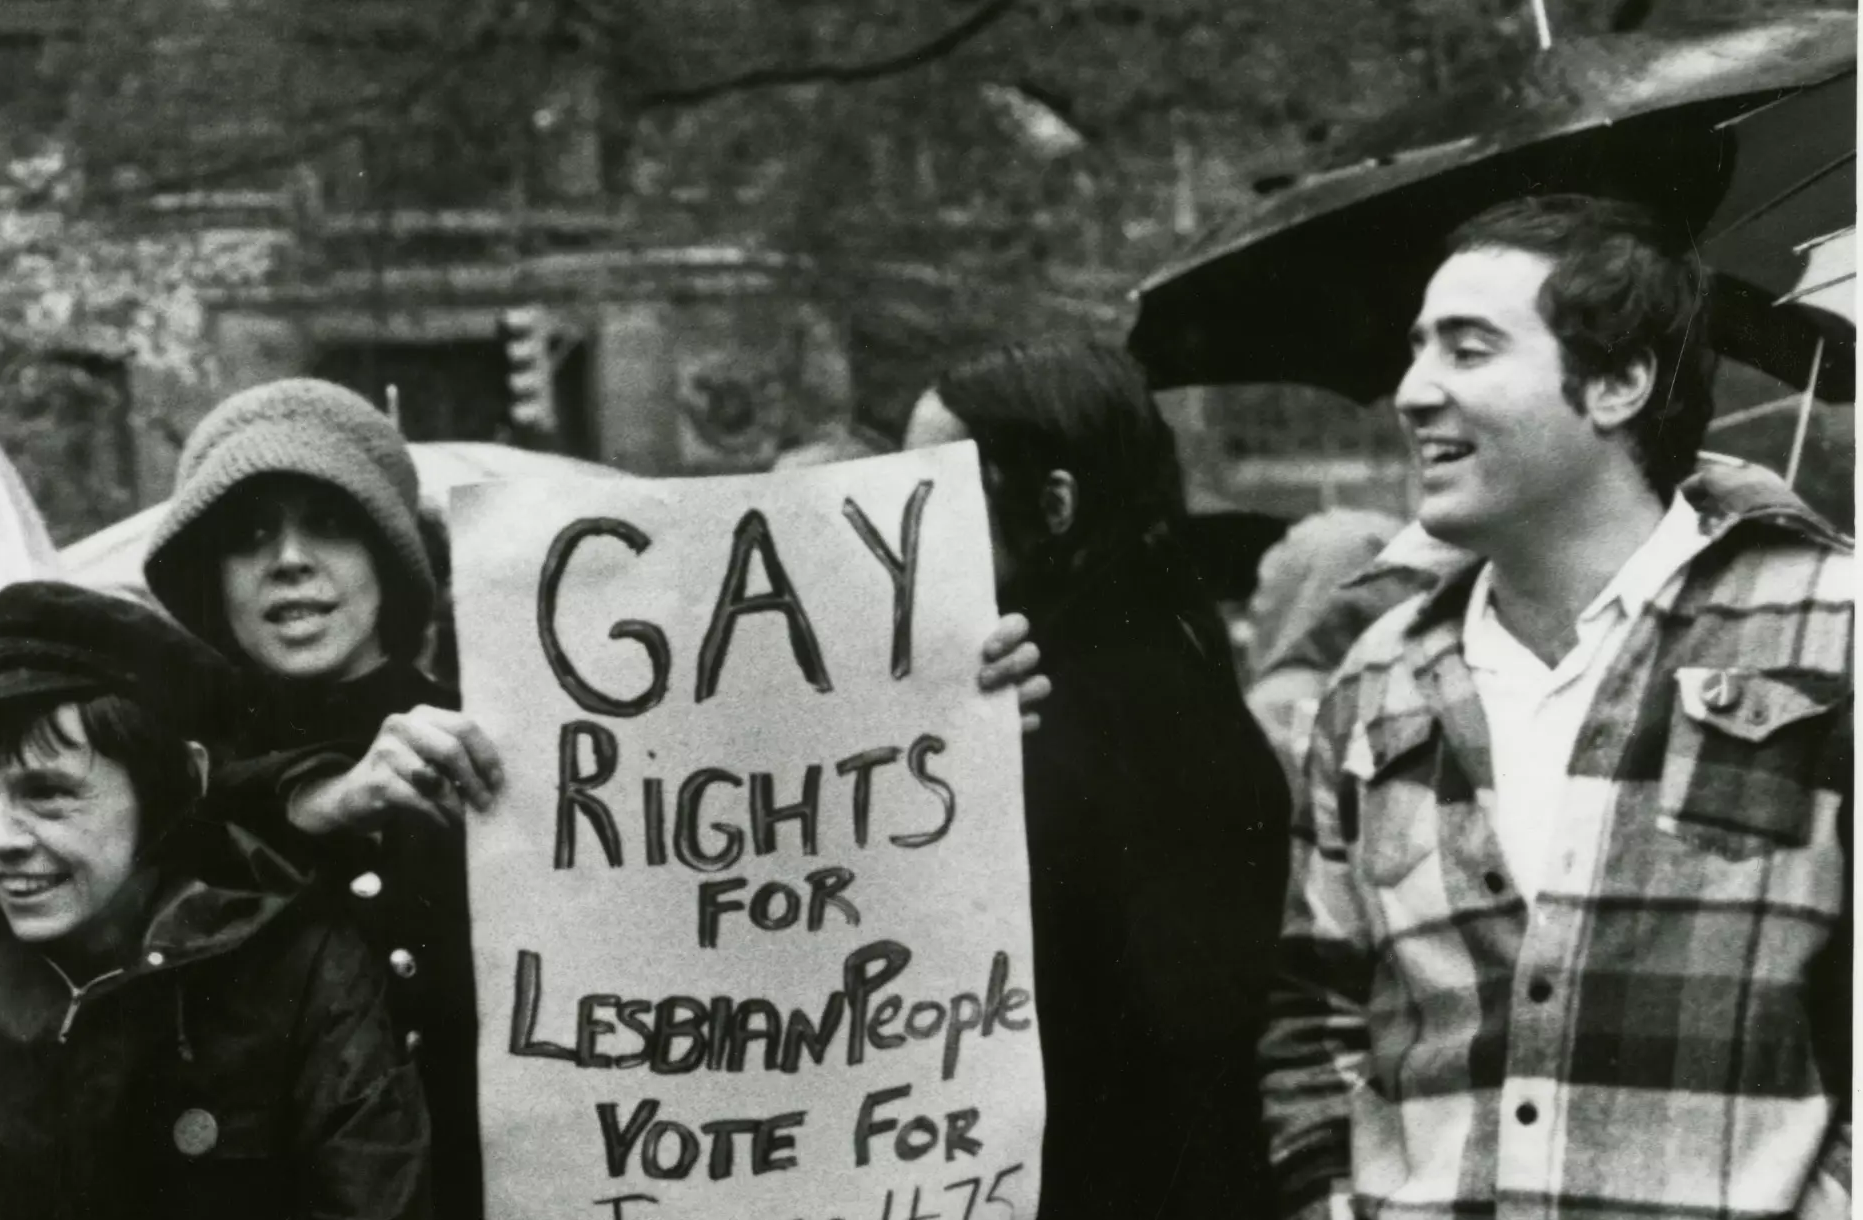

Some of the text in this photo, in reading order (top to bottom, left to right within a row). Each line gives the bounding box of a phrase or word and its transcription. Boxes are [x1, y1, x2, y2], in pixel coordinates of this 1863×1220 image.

[538, 480, 934, 717] GAY
[698, 866, 860, 948] FOR
[509, 950, 845, 1074] LESBIAN
[595, 1084, 985, 1180] VOTE FOR
